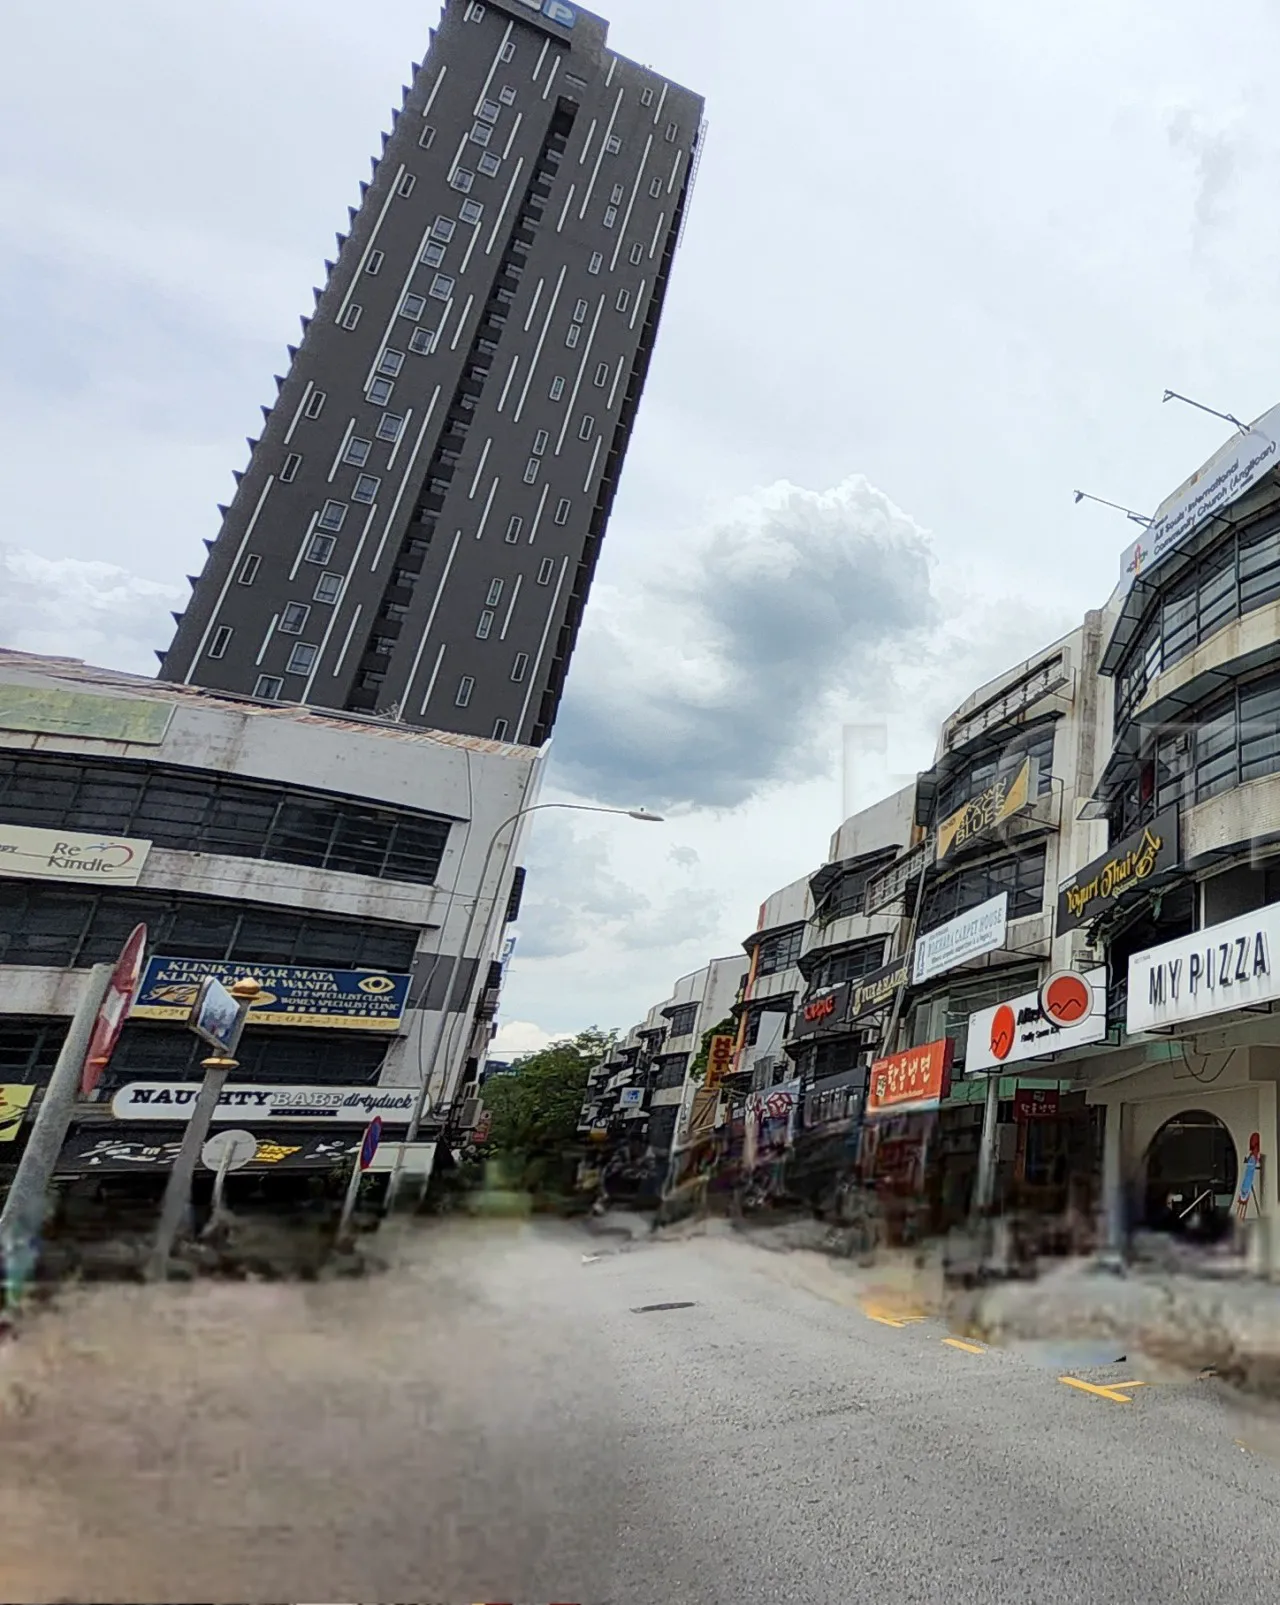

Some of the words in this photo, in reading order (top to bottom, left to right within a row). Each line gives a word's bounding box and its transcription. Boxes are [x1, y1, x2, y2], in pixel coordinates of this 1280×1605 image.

[1153, 515, 1196, 555] Community
[1197, 487, 1227, 518] Church
[955, 799, 1005, 845] BLUES
[52, 842, 81, 856] Re
[48, 855, 114, 872] Kindle
[168, 961, 229, 974] KLINIK
[234, 966, 288, 979] PAKAR
[293, 970, 335, 981] MATA
[1149, 958, 1182, 1005] MY
[1189, 931, 1270, 994] PIZZA
[281, 980, 339, 991] WANITA
[129, 1089, 271, 1105] NAUHTY
[270, 1092, 344, 1107] BABE
